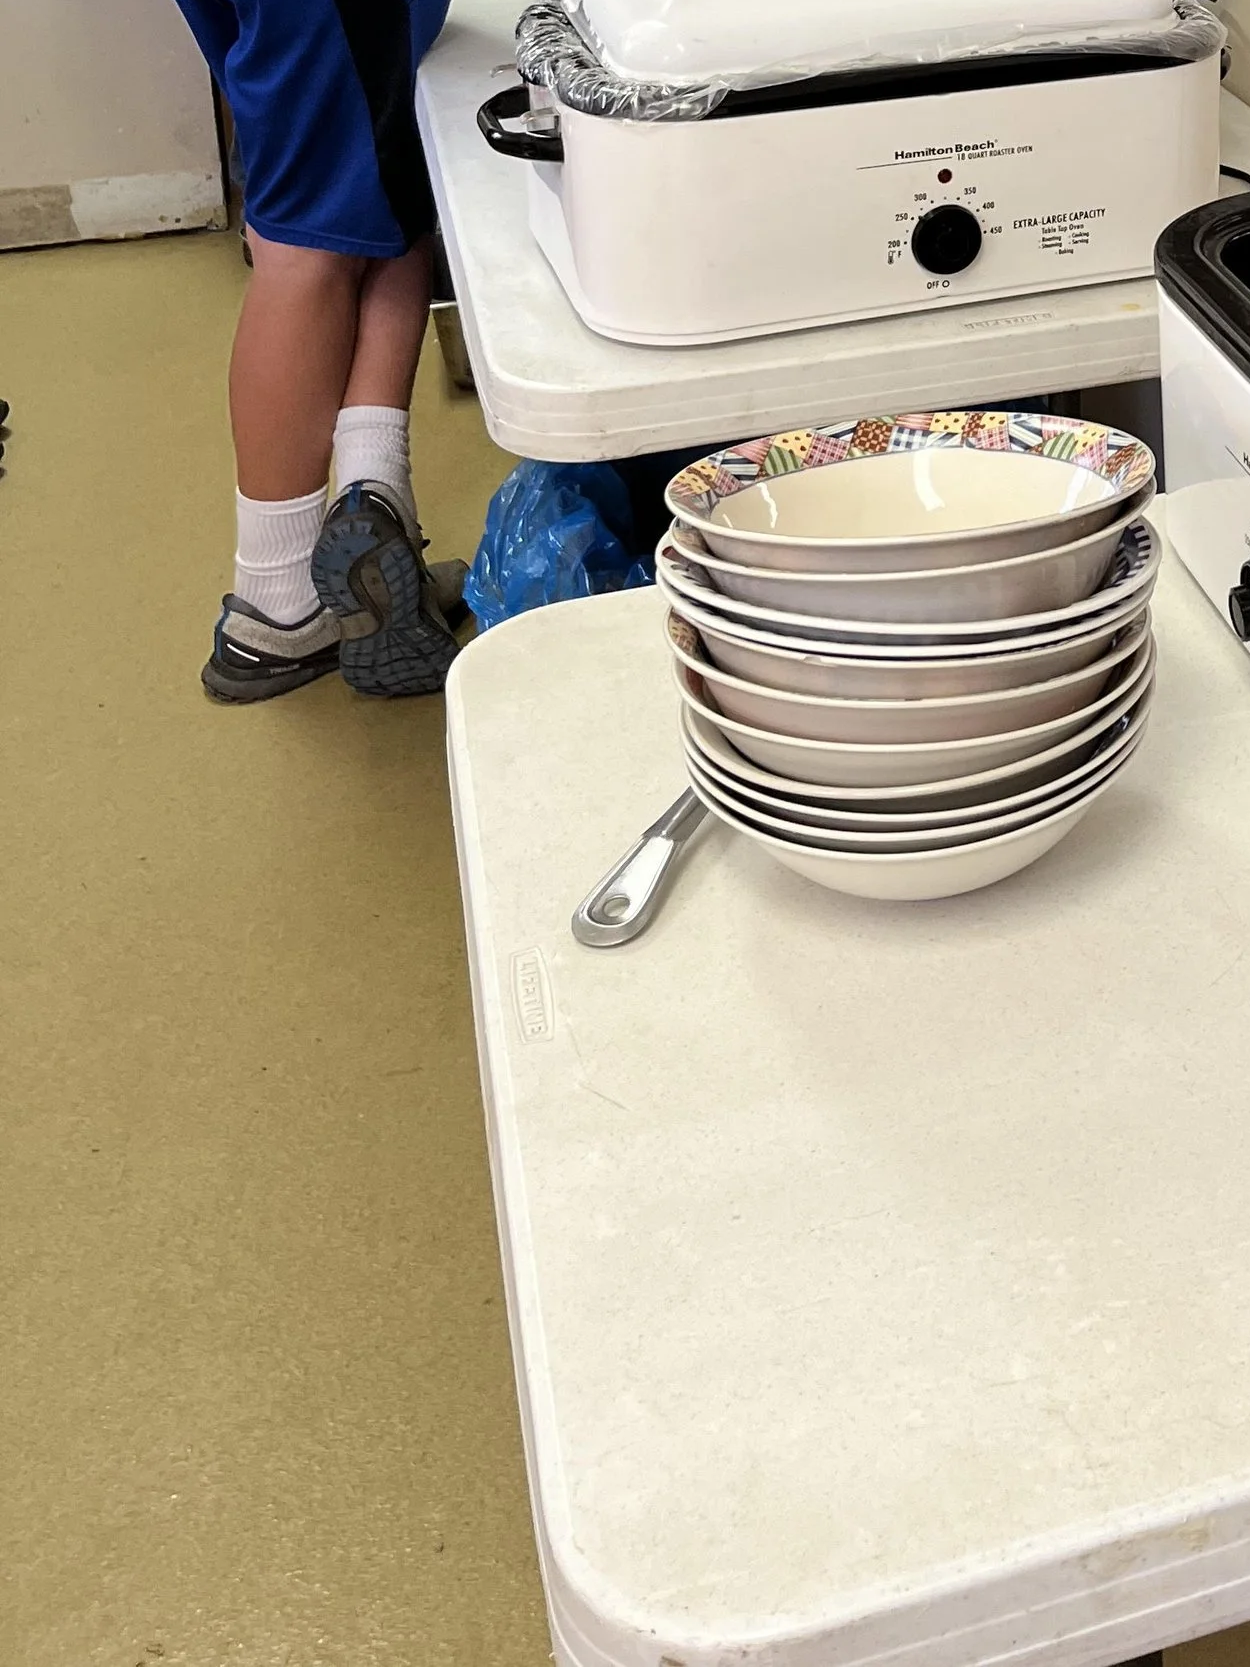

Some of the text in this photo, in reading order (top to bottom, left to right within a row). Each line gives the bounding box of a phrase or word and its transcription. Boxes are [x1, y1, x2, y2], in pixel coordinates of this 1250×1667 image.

[894, 140, 995, 160] Hamilton Beach
[957, 145, 1033, 161] 18 QUART ROASTER OVEN
[964, 187, 977, 195] 350
[914, 193, 927, 201] 300
[895, 213, 908, 222] 250
[1013, 208, 1106, 229] EXTRA-LARGE CAPACITY
[990, 226, 1002, 234] 450
[888, 240, 900, 248] 200
[927, 281, 939, 290] OFF
[519, 960, 543, 1034] LIFETIME
